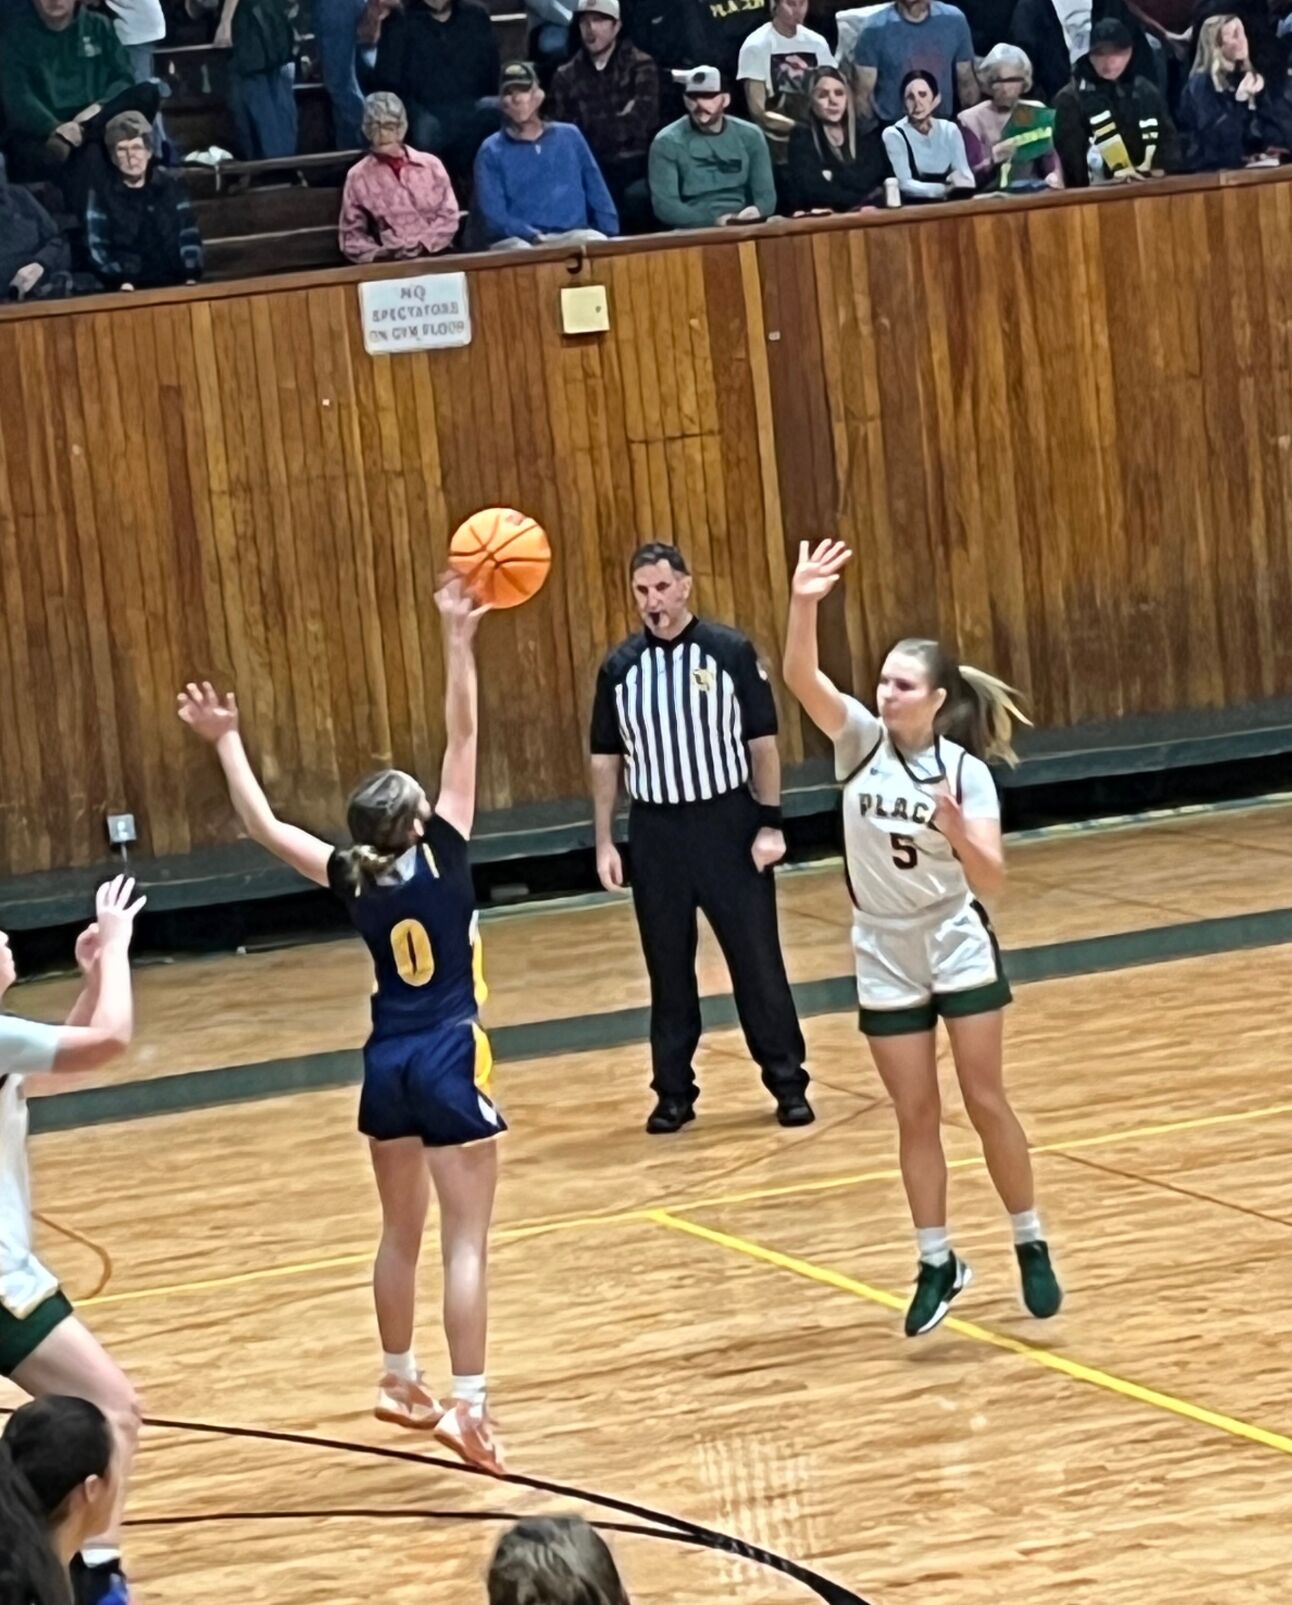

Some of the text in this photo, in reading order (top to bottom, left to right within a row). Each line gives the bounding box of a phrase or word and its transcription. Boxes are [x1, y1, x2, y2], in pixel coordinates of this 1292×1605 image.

[858, 793, 935, 829] PLAC
[890, 832, 918, 870] 5
[390, 918, 435, 987] 0
